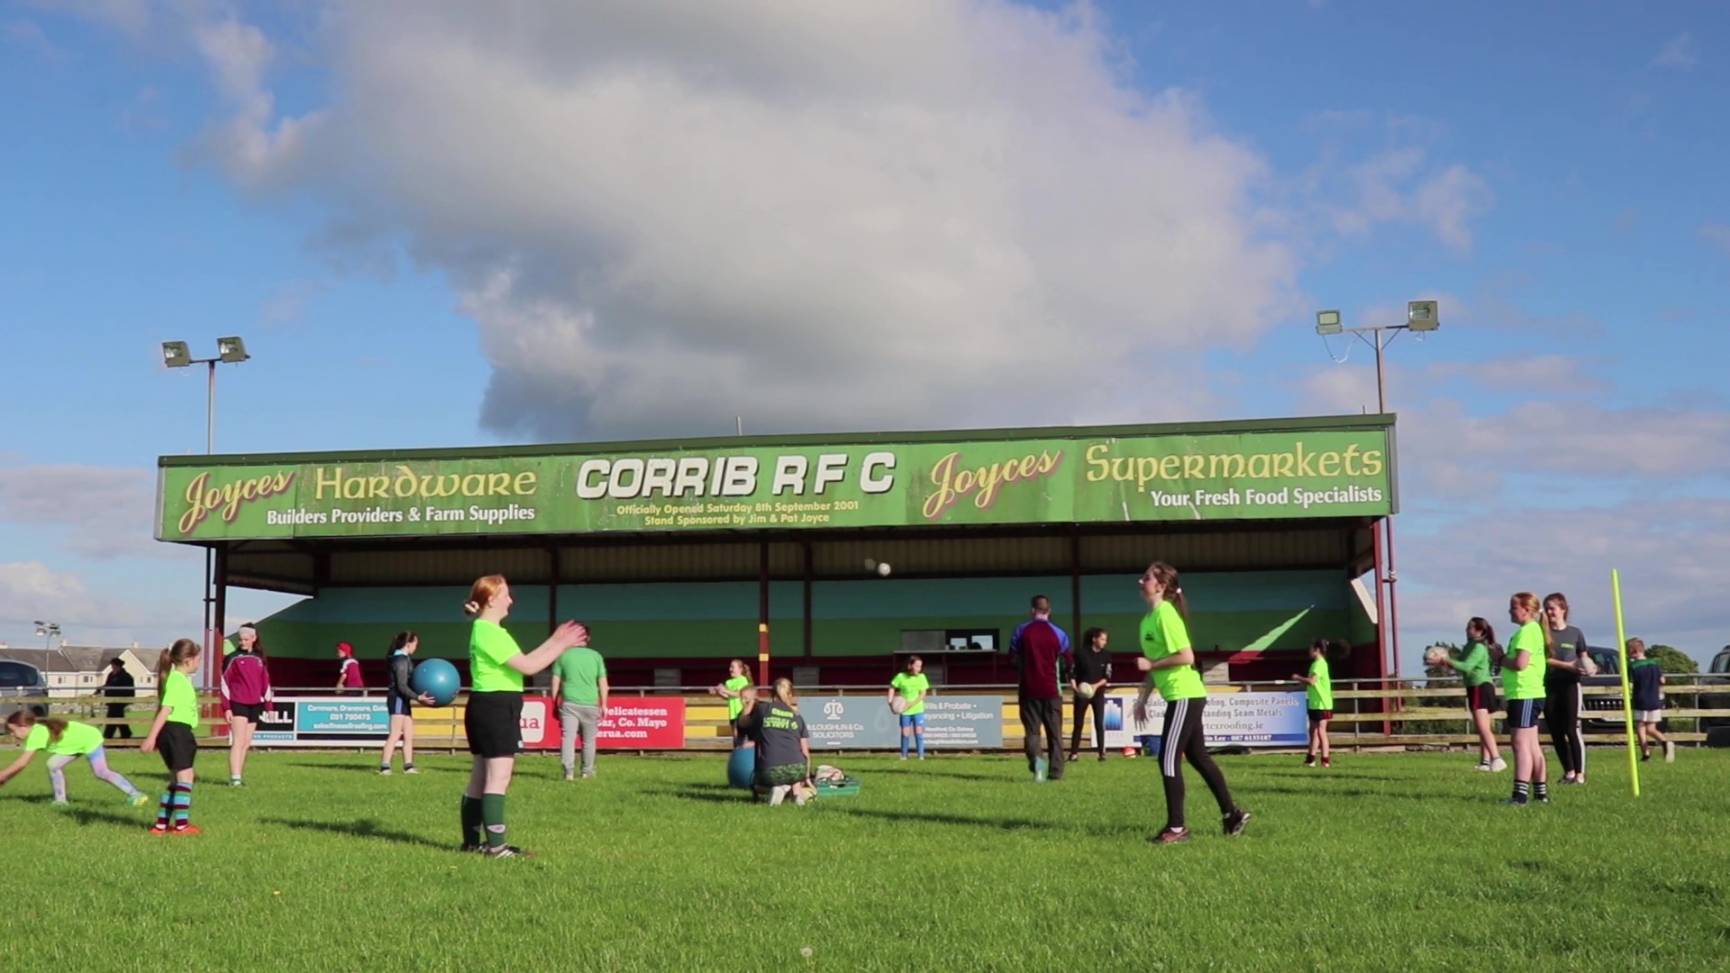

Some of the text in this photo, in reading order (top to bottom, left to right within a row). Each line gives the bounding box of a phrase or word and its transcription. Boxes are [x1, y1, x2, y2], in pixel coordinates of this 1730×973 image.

[576, 456, 759, 499] CORRIB
[922, 442, 1383, 519] Joyces Supermarkets
[178, 465, 538, 534] Joyces Hardware
[1151, 486, 1383, 508] Your Fresh Food Specialists
[267, 503, 536, 526] Builders Providers & Farm Supplies
[616, 500, 859, 516] Officially Opened Saturday 8th September 2001
[645, 511, 830, 527] Stand Sponsored by Jim & Pat Joyce
[944, 702, 972, 710] Probate
[1229, 697, 1269, 706] Composite
[605, 706, 668, 716] elicatessen
[961, 711, 994, 720] Litigation
[1203, 709, 1231, 718] tanding
[1234, 708, 1255, 717] Seam
[618, 717, 636, 727] Co.
[637, 718, 668, 729] Mayo
